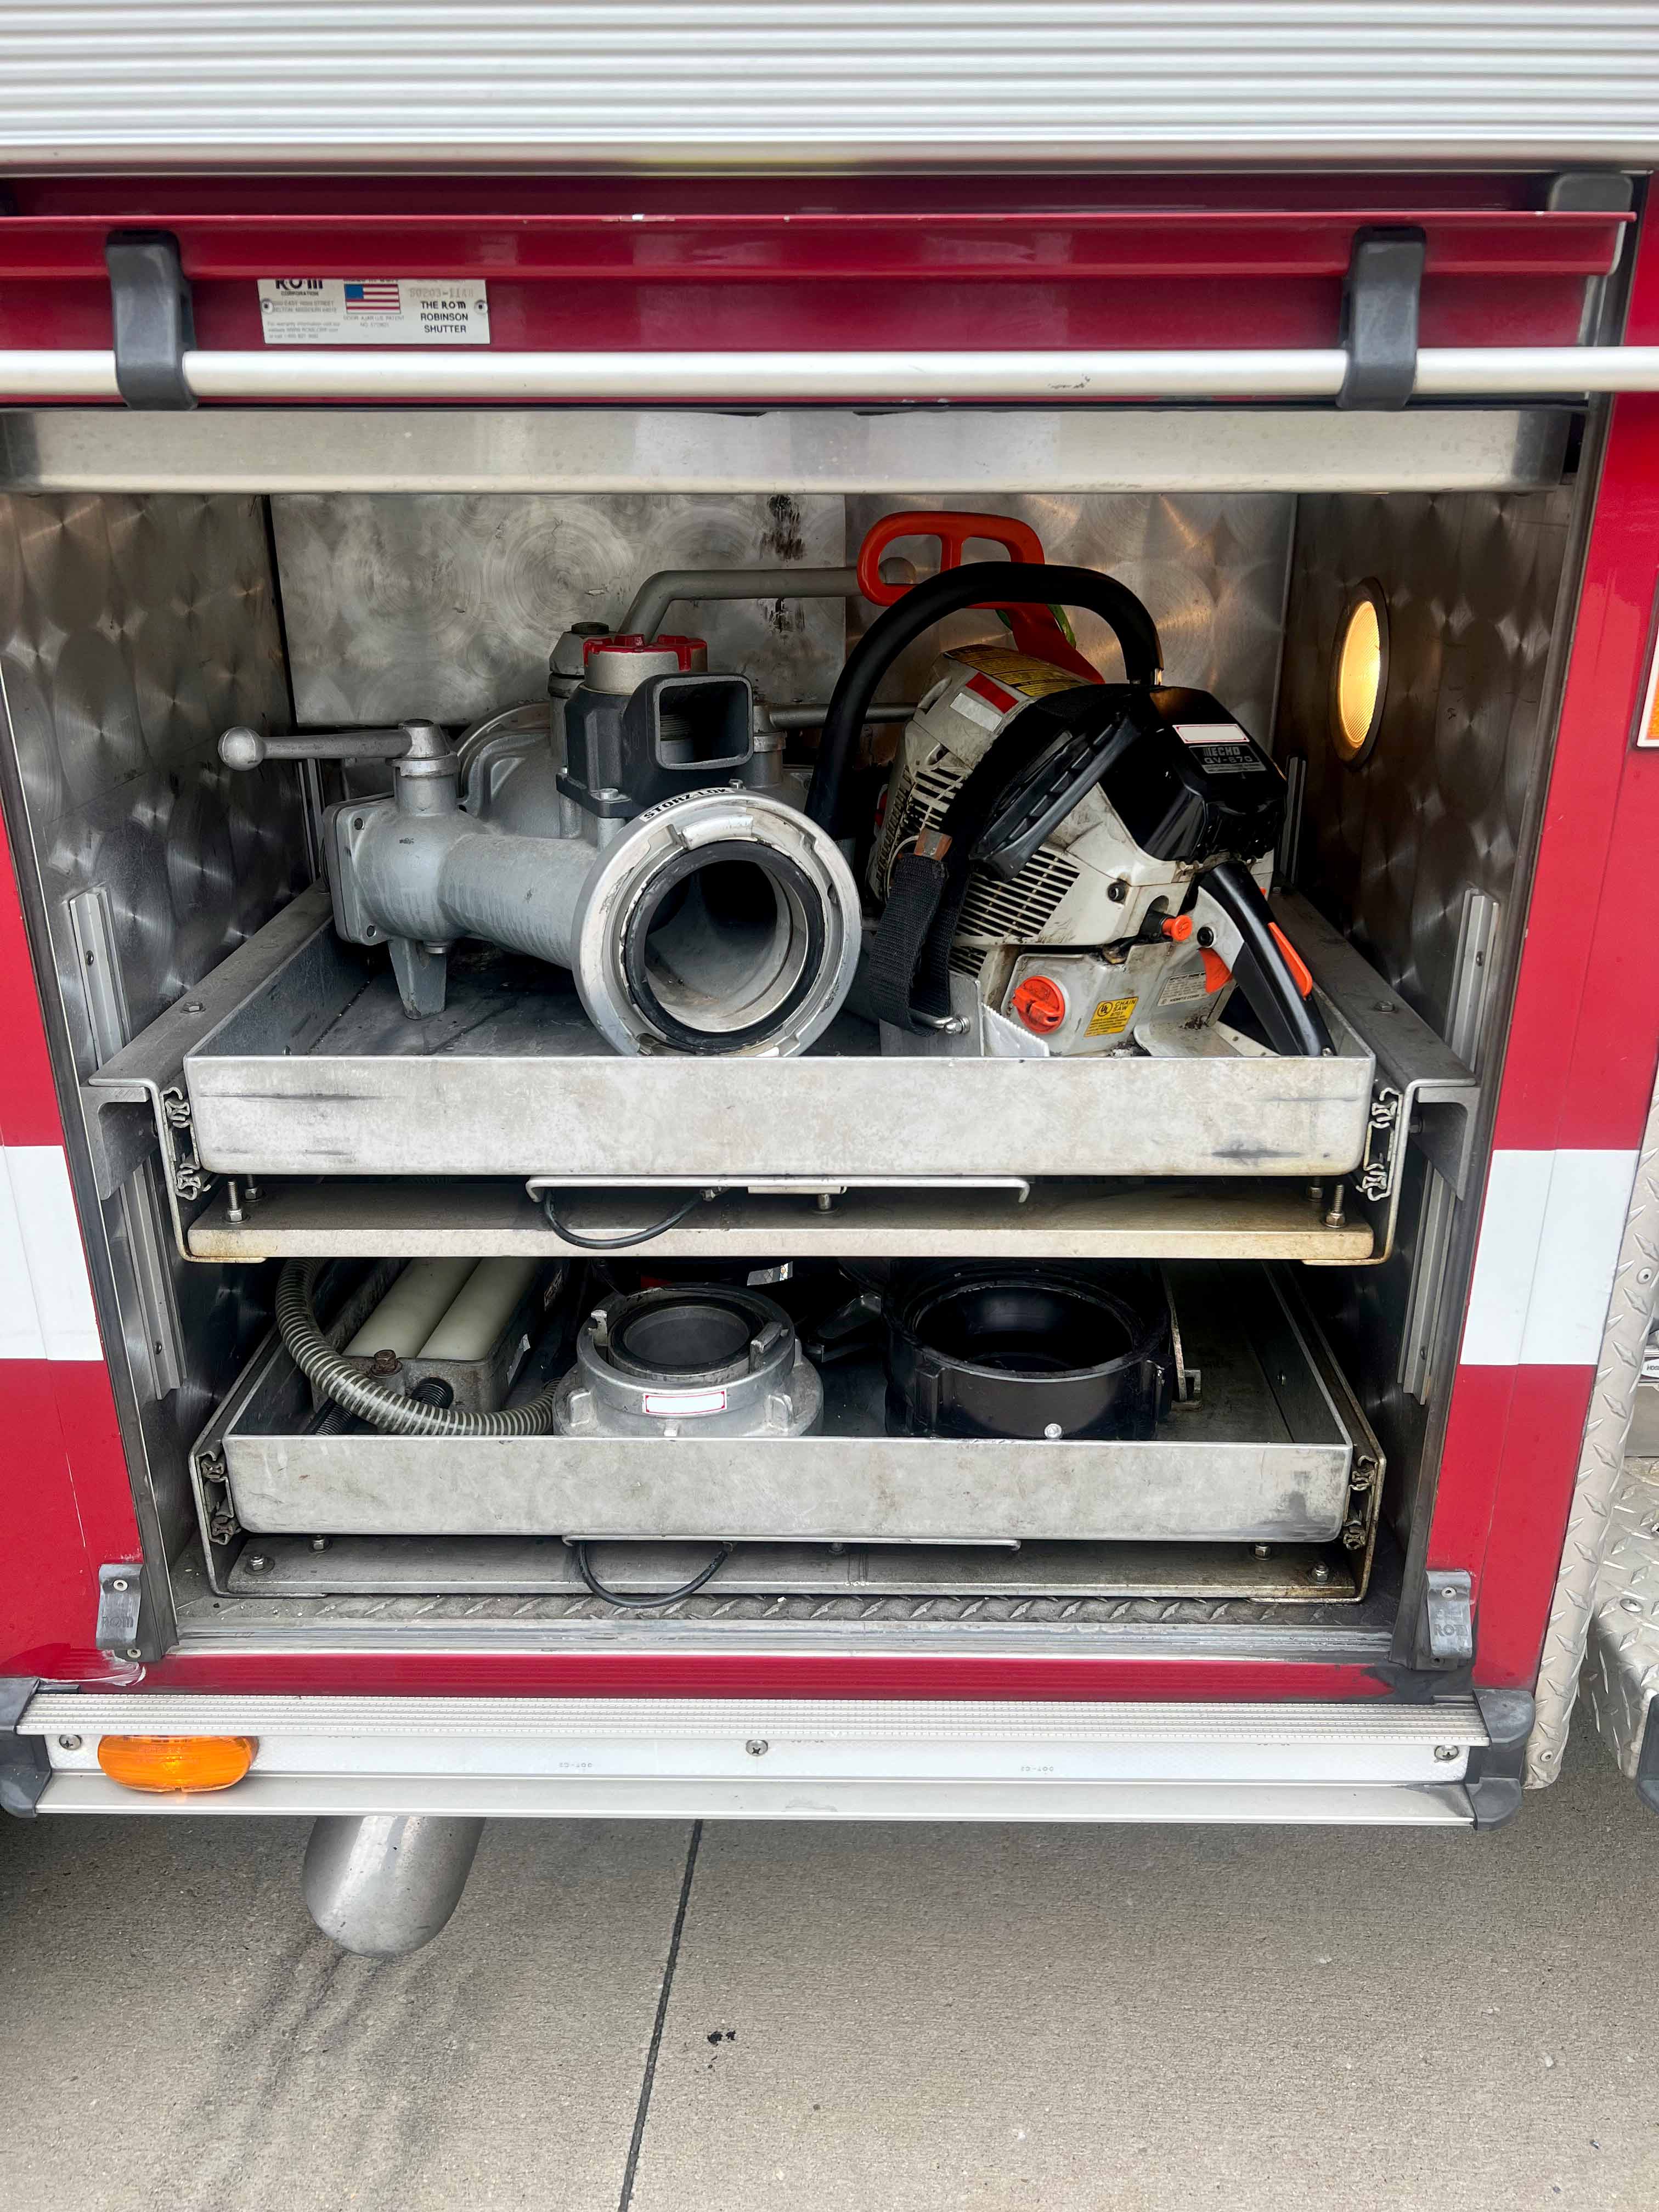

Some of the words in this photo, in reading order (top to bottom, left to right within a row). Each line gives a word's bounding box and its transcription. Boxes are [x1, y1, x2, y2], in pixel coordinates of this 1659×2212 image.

[420, 301, 438, 309] THE
[420, 313, 469, 321] ROBINSON
[424, 325, 467, 333] SHUTTER
[1210, 747, 1241, 757] ECHO
[644, 788, 730, 819] STORZ-LOK
